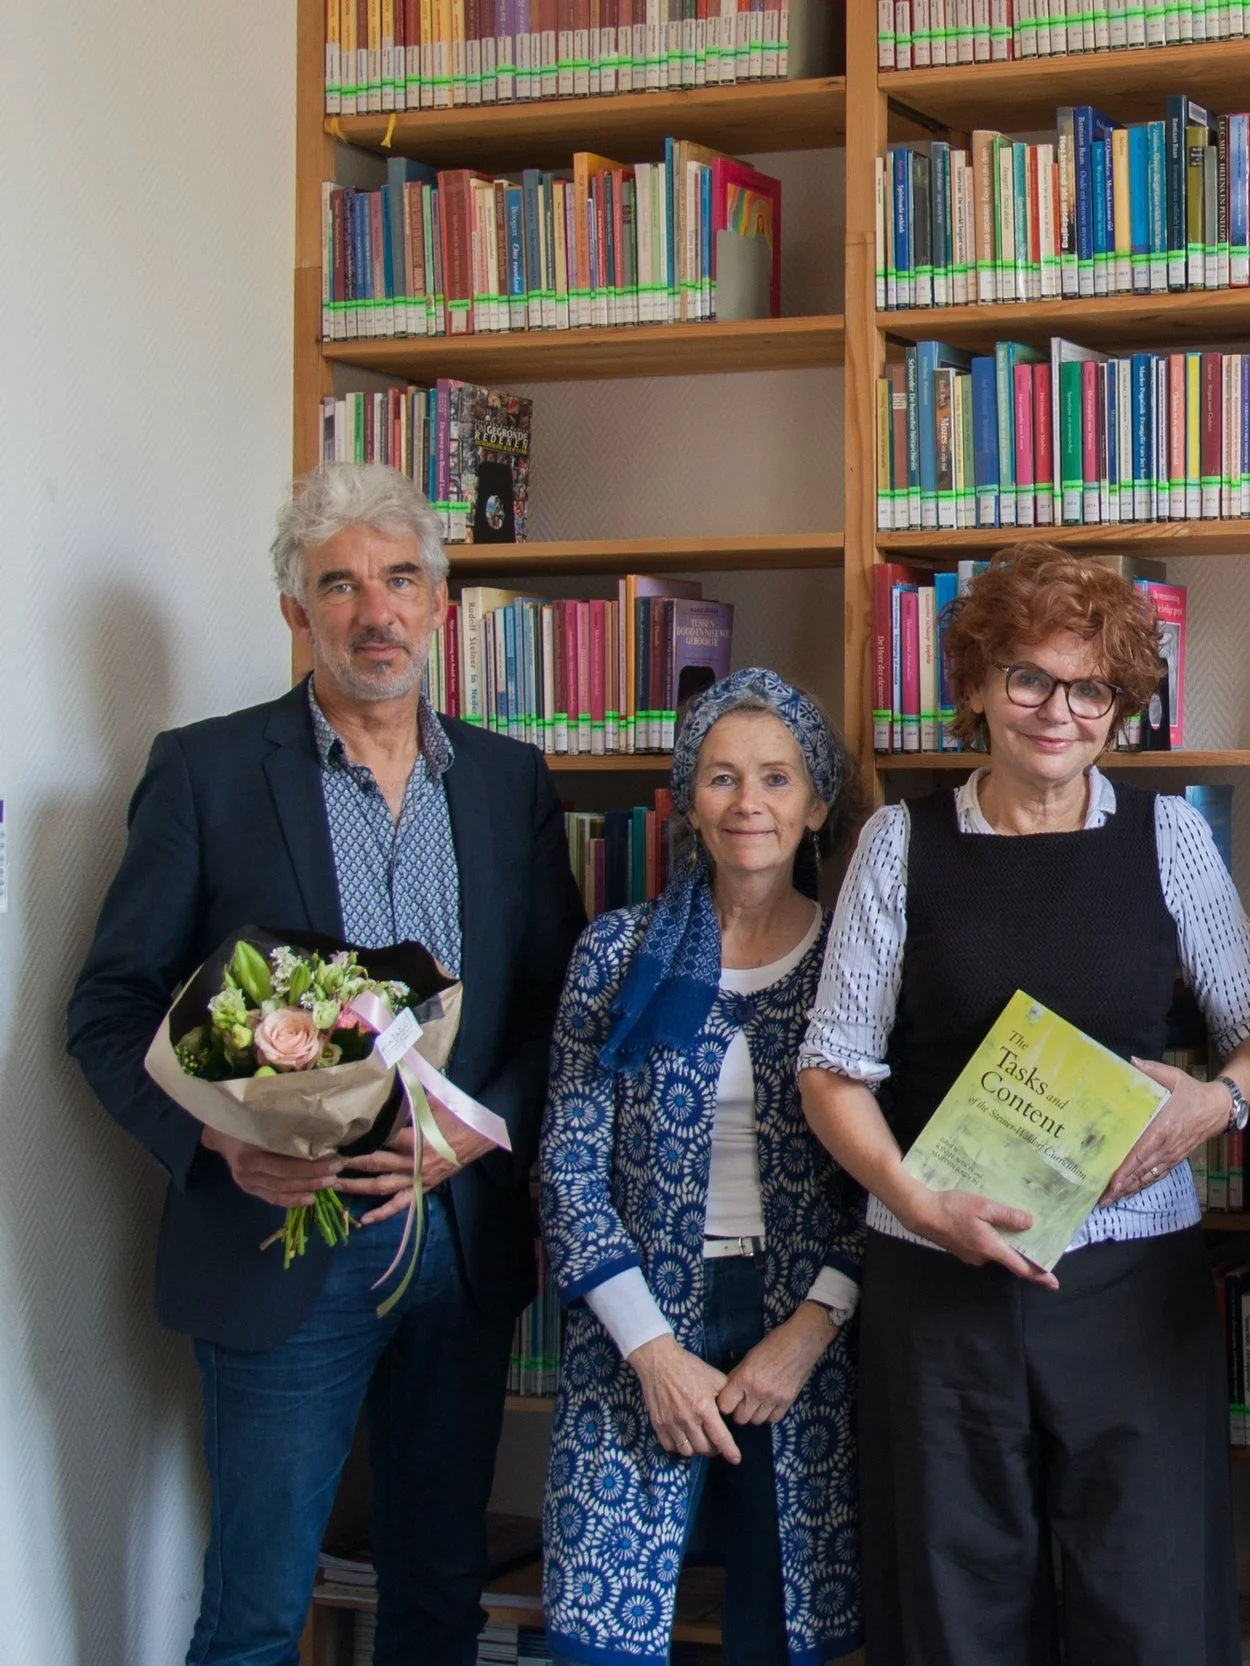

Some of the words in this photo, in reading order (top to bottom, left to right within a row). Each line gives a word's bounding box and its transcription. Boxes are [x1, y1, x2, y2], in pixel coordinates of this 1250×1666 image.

[510, 206, 519, 236] Boogert
[941, 418, 949, 444] Mozes
[468, 602, 476, 631] Rudolf
[469, 638, 477, 669] Steiner
[1009, 1030, 1029, 1050] The
[996, 1046, 1048, 1096] Tasks
[1046, 1094, 1069, 1110] and
[981, 1070, 1065, 1138] Content
[969, 1096, 979, 1106] of
[978, 1100, 989, 1113] the
[989, 1109, 1047, 1152] Steiner-Waldorf
[1044, 1146, 1087, 1180] Curriculum
